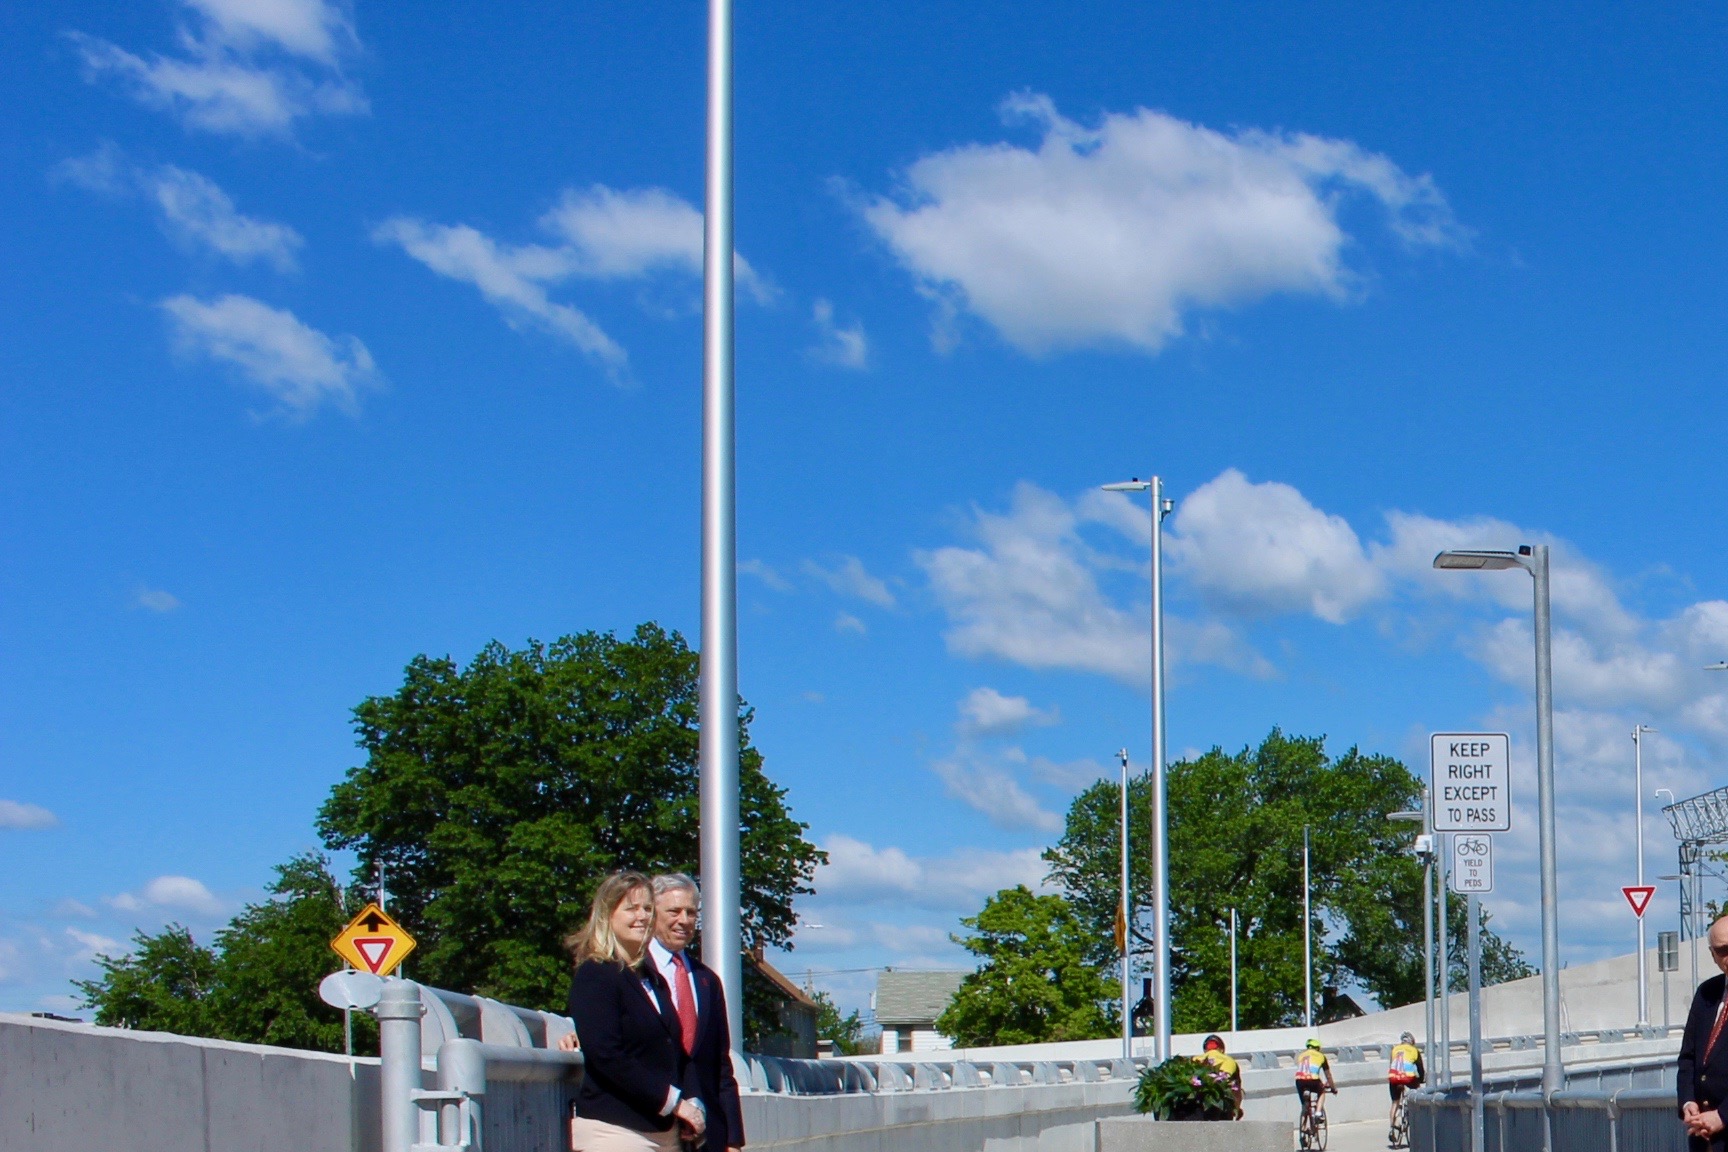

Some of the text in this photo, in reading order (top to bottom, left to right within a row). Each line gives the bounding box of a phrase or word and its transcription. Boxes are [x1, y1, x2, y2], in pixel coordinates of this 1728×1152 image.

[1450, 743, 1490, 757] KEEP
[1448, 764, 1492, 779] RIGHT
[1444, 786, 1497, 801] EXCEPT
[1447, 808, 1496, 822] TO PASS
[1463, 859, 1482, 867] YIELD
[1469, 869, 1477, 877] TO
[1464, 879, 1482, 887] PEDS
